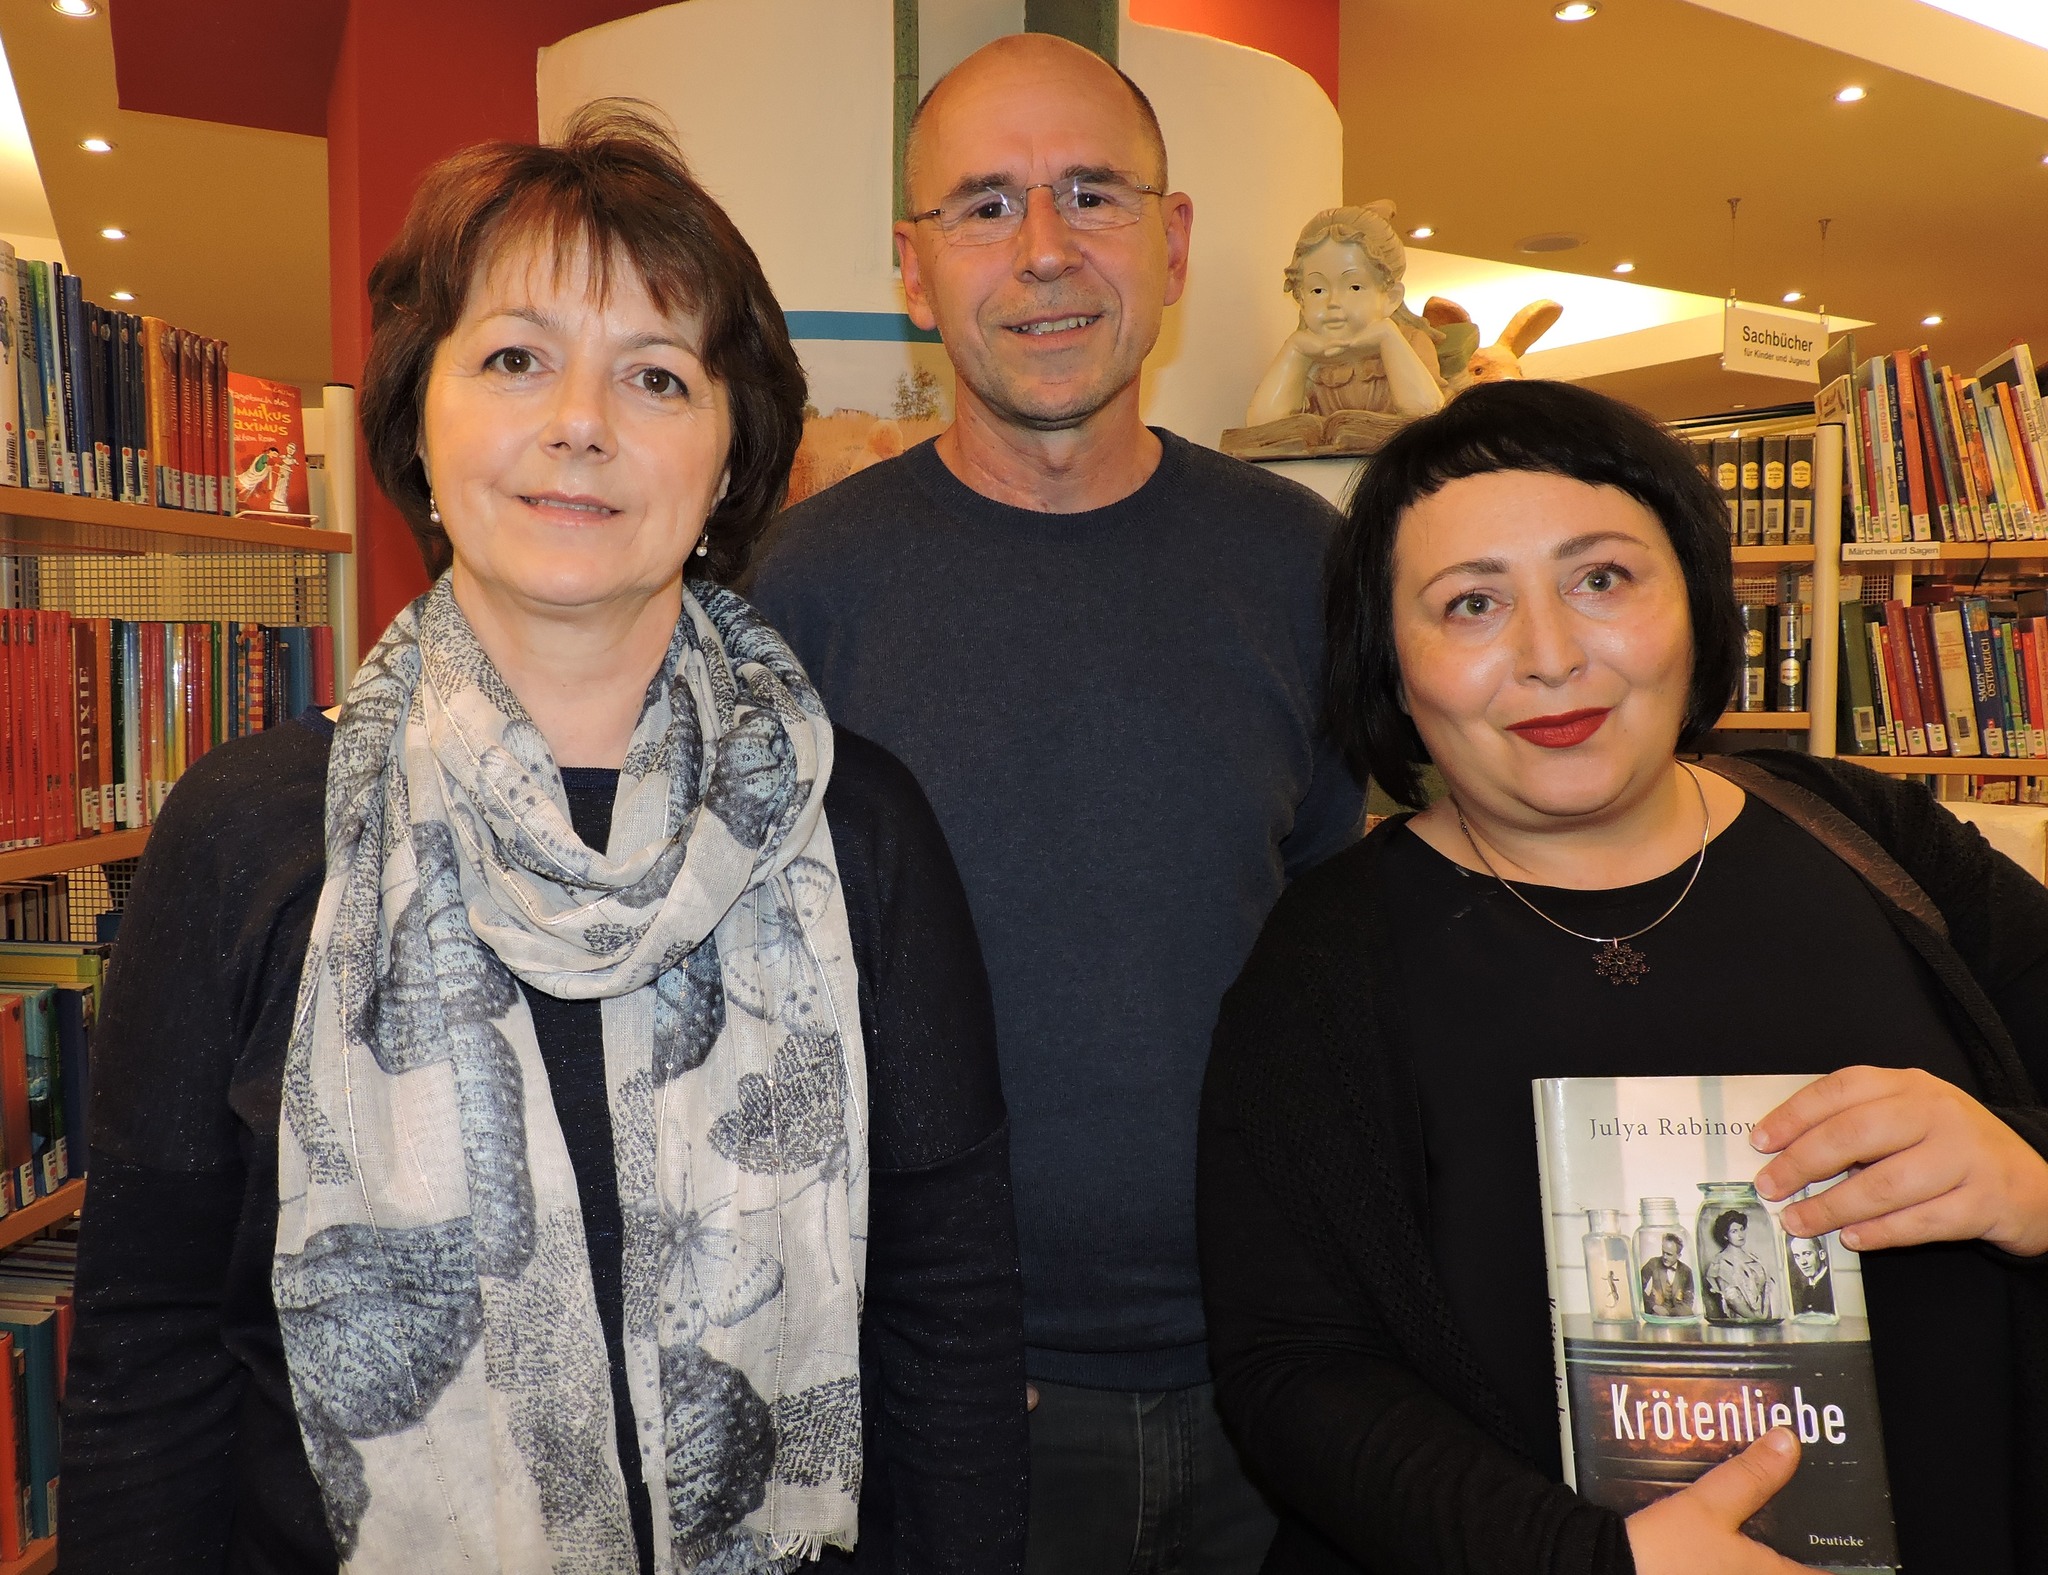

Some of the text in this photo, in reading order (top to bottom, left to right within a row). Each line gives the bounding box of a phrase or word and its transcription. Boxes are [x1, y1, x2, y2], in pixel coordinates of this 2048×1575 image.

[1743, 326, 1812, 352] Sachbücher
[1744, 347, 1753, 356] für
[1754, 350, 1774, 360] Kinder
[1789, 355, 1810, 367] Jugend
[1902, 363, 1912, 404] Pinocchio
[1848, 547, 1887, 555] Märchen
[1910, 547, 1938, 555] Sagen
[1980, 638, 1996, 697] ÖSTERREICH
[1976, 673, 1987, 702] SAGEN
[79, 666, 91, 761] DIXIE
[1590, 1118, 1649, 1142] Julya
[1610, 1382, 1847, 1445] Krötenliebe
[1808, 1534, 1864, 1548] Deuticke
